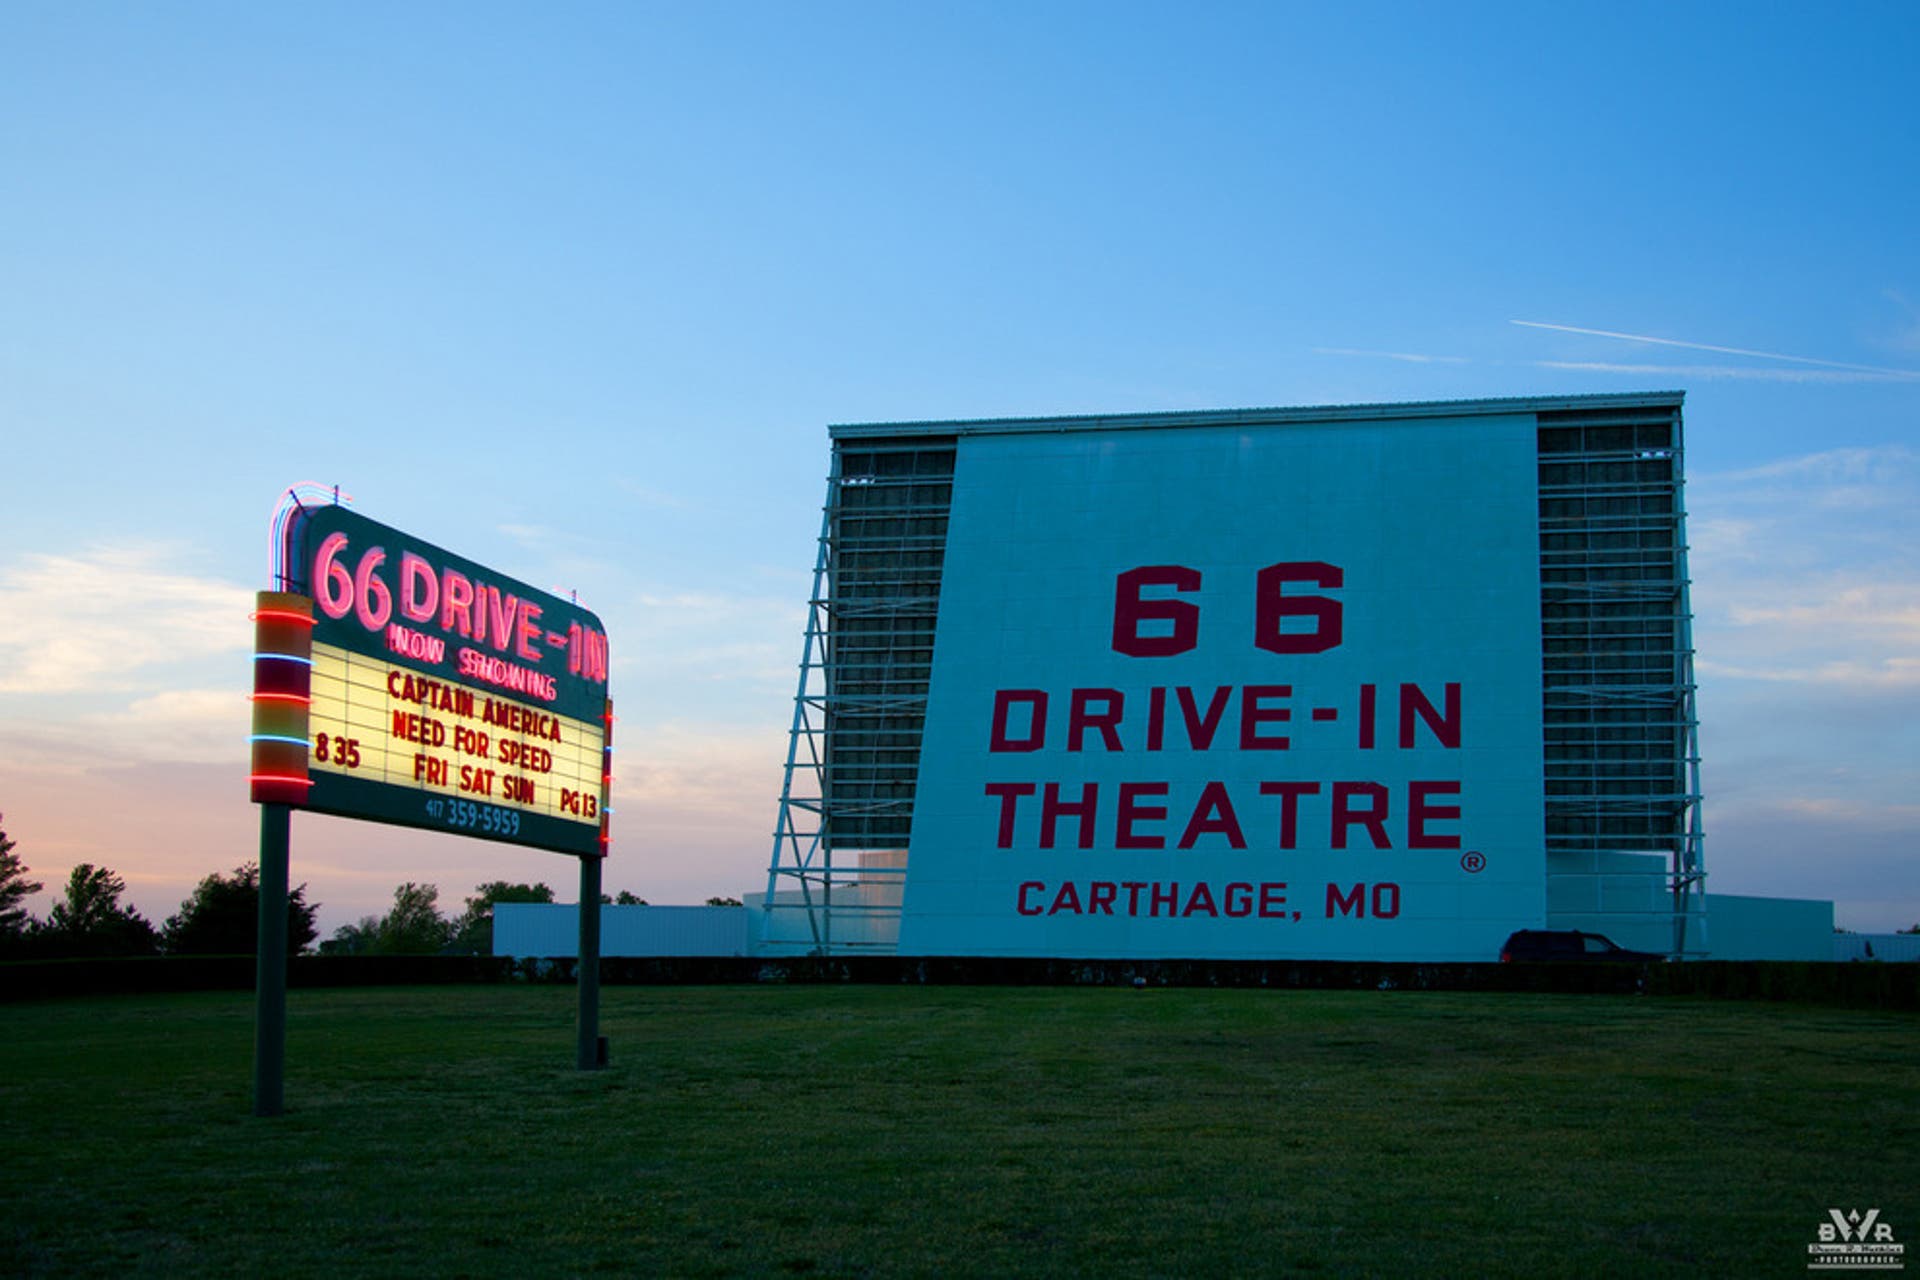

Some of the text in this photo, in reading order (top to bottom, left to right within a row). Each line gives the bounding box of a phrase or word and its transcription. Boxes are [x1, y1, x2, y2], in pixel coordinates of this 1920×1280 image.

[312, 531, 606, 684] 66 DRIVE-IN
[385, 622, 557, 701] NOW SHOWING
[387, 671, 561, 744] CAPTAIN AMERICA
[392, 709, 552, 774] NEED FOR SPEED
[989, 682, 1461, 753] DRIVE-IN
[414, 753, 535, 805] FRI SAT SUN
[425, 799, 443, 818] 417
[985, 781, 1461, 850] THEATRE
[1016, 881, 1401, 923] CARTHAGE, MO
